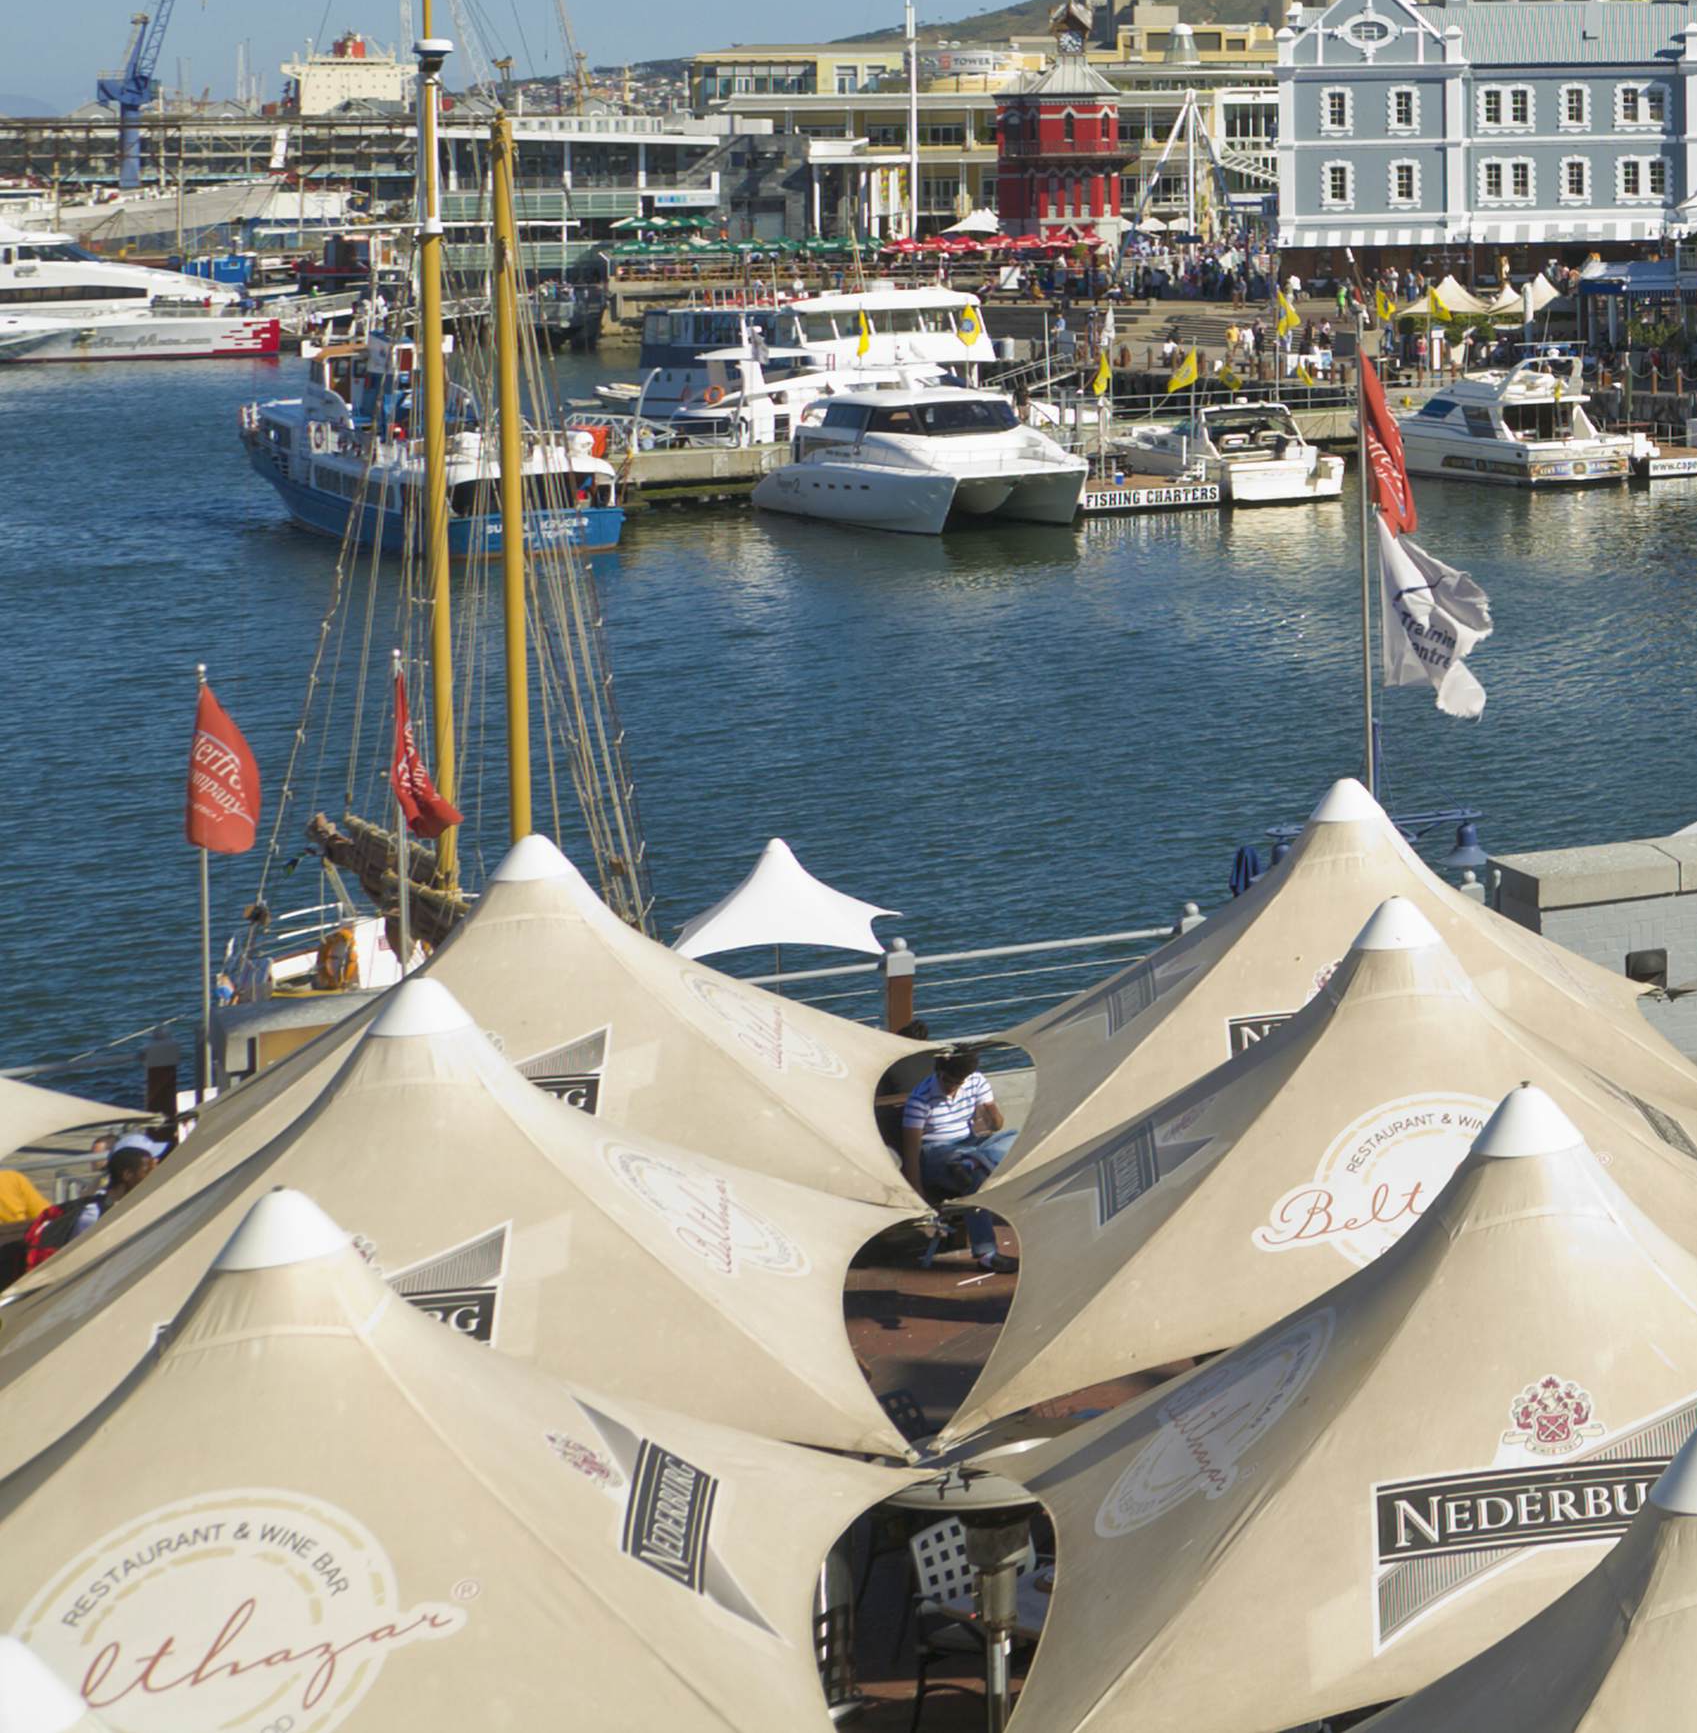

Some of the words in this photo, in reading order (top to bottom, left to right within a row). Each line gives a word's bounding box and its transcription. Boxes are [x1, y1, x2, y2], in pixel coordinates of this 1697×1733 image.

[953, 57, 990, 65] TOWER
[1086, 491, 1141, 508] FISHING
[1146, 487, 1217, 504] CHARTERS
[1346, 1113, 1435, 1174] RESTAURANT
[1440, 1113, 1453, 1125] &
[1458, 1115, 1490, 1130] WIN
[639, 1455, 697, 1582] NEDERBURG
[1393, 1481, 1650, 1549] NEDERBU
[62, 1522, 227, 1628] RESTAURANT
[233, 1522, 250, 1541] &
[260, 1523, 317, 1560] WINE
[311, 1552, 349, 1598] BAR
